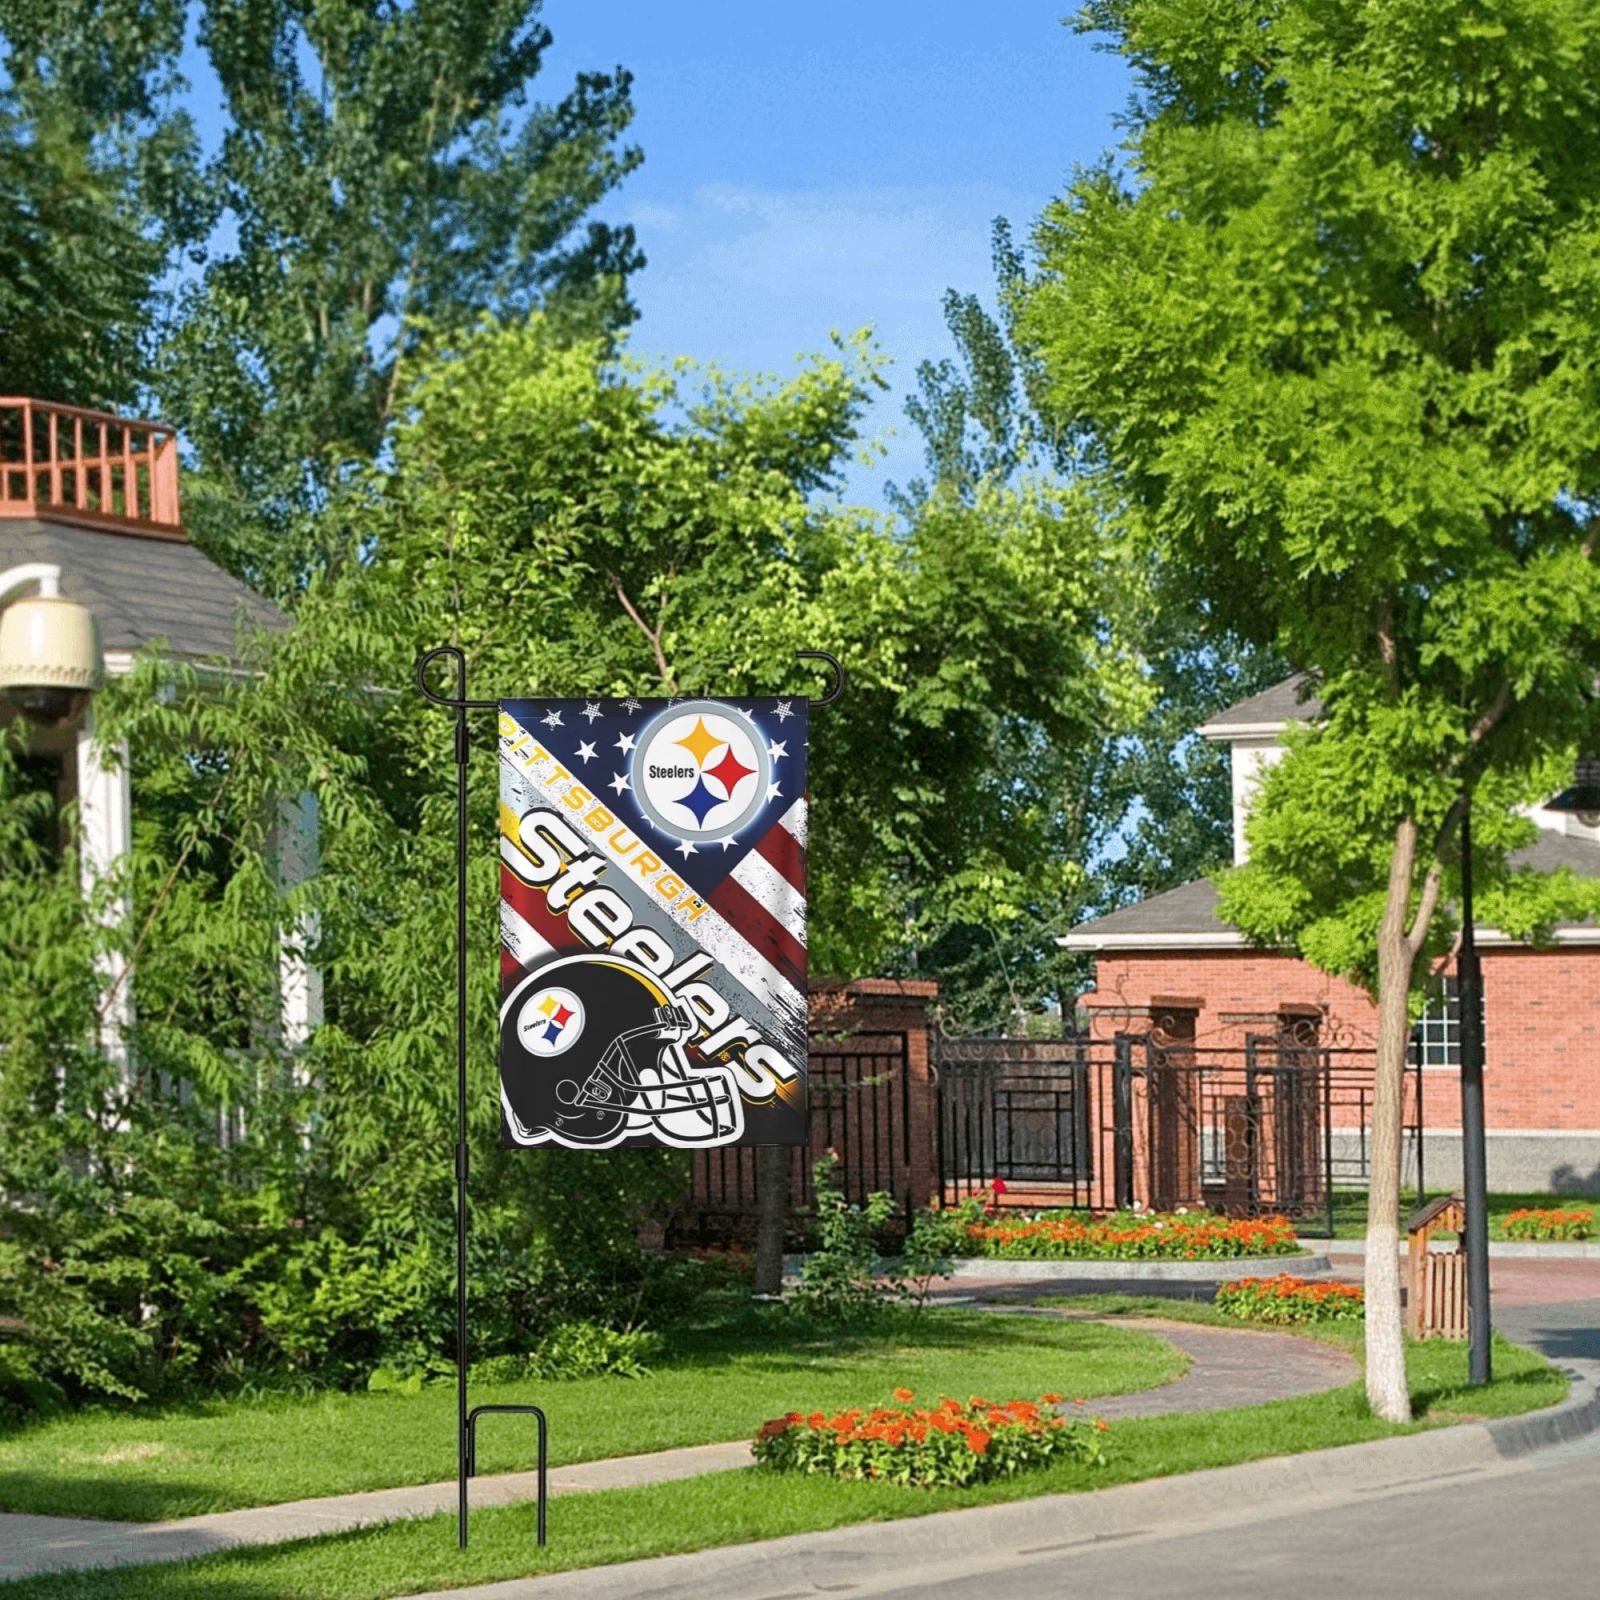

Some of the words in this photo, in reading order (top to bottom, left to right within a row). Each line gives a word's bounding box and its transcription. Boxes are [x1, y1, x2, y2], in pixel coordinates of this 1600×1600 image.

[499, 714, 709, 921] PITTSBURGH
[649, 764, 694, 779] Steelers
[500, 808, 798, 1099] Steelers
[523, 1019, 547, 1033] Steelers
